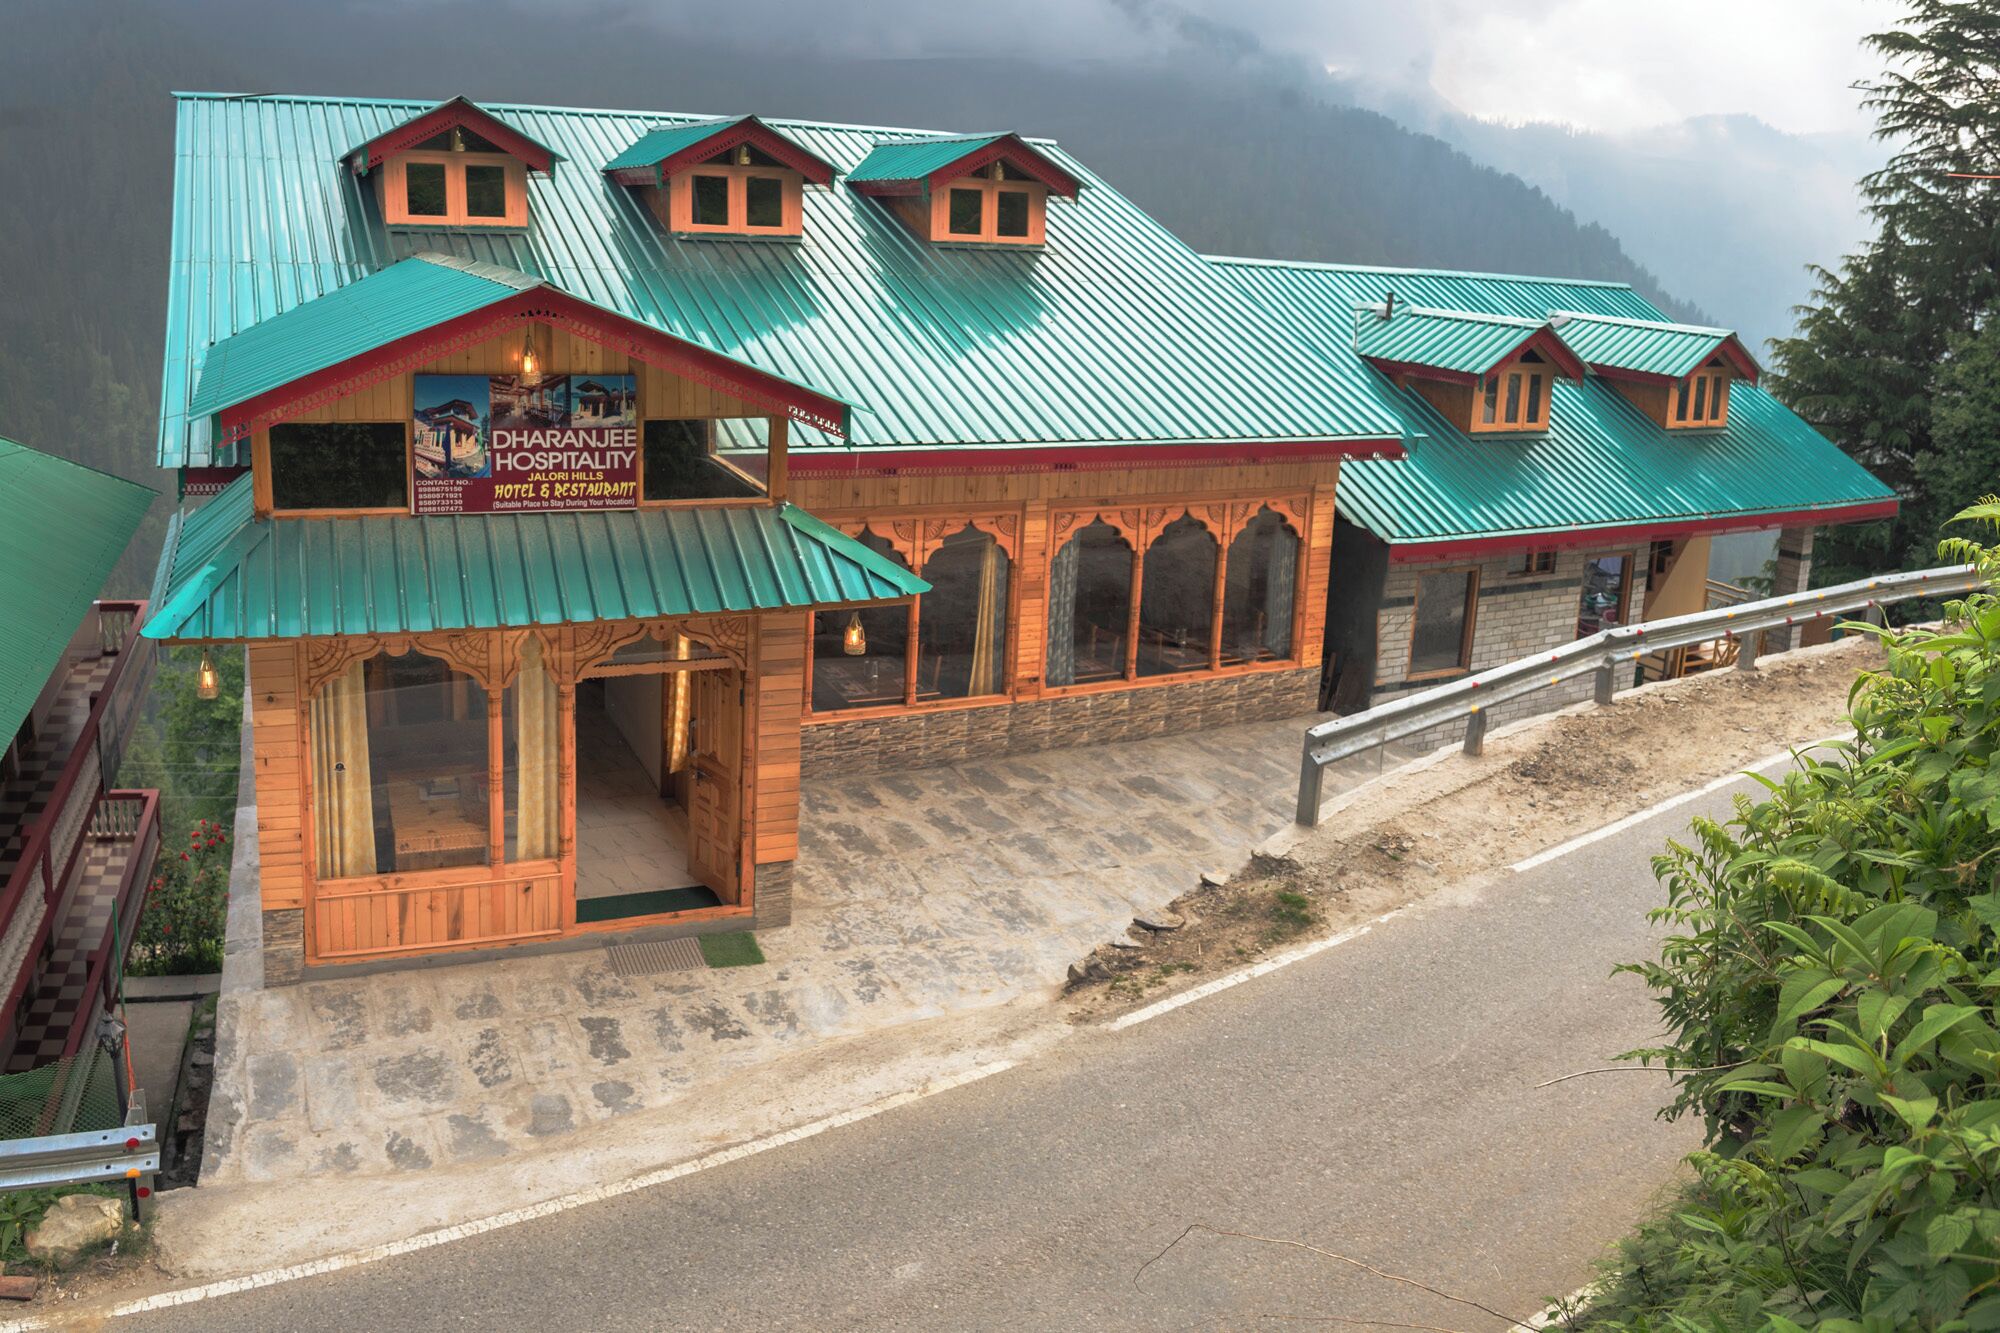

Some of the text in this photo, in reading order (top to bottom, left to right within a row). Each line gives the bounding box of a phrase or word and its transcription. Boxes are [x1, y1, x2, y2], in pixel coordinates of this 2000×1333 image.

[492, 429, 637, 449] DHARANJEE
[495, 450, 636, 471] HOSPITALITY
[528, 471, 604, 482] JALORI HILLS
[494, 481, 637, 499] HOTEL & RESTAURANT
[492, 501, 522, 510] (Suitable
[522, 500, 541, 508] Place
[550, 498, 565, 509] Stay
[565, 498, 588, 508] During
[588, 498, 604, 506] Your
